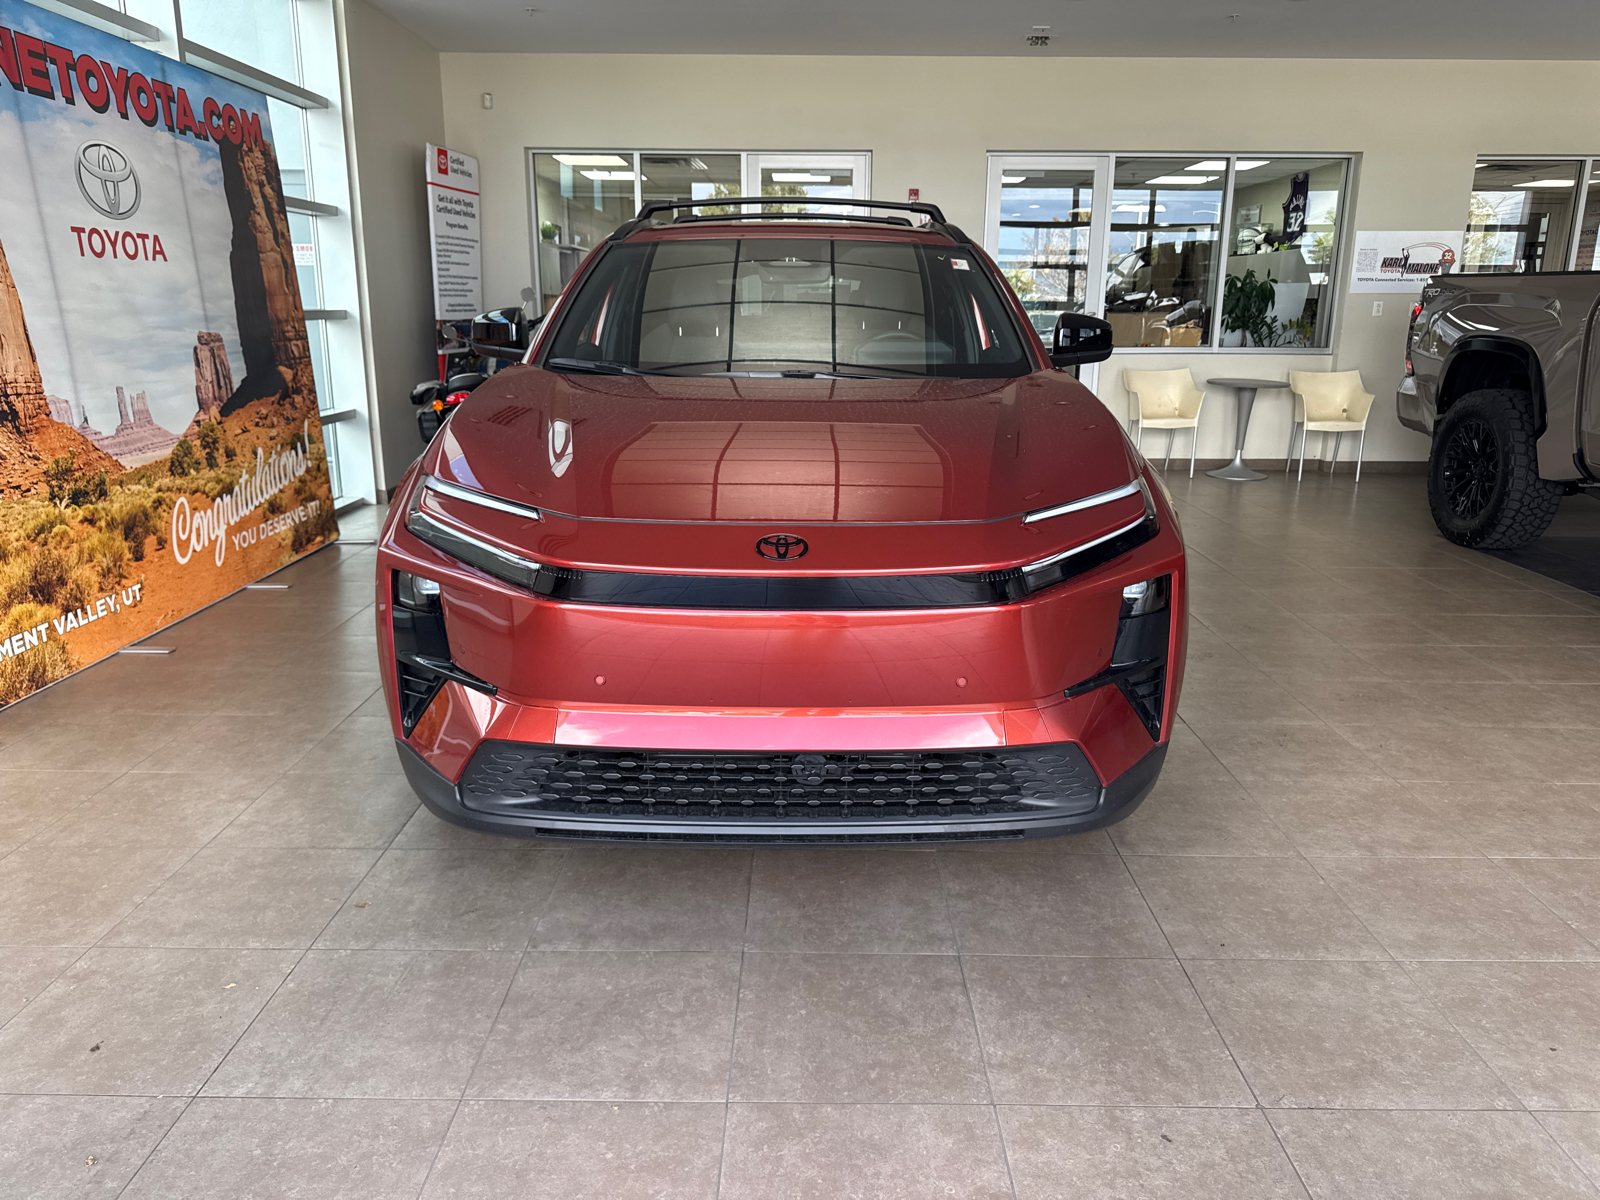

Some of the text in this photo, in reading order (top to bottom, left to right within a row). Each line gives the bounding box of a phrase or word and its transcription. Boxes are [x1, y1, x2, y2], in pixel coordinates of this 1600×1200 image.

[450, 156, 465, 167] Certified
[436, 204, 452, 215] Certified
[462, 198, 474, 209] Toyota
[1286, 211, 1304, 232] 32
[70, 226, 168, 262] TOYOTA
[1444, 252, 1452, 260] 32
[1380, 257, 1440, 274] KARL MALONE
[1424, 288, 1441, 298] TRD
[172, 418, 312, 567] Congratulations!
[231, 499, 321, 551] YOU DESERVE IT!
[52, 593, 121, 636] VALLEY,
[121, 583, 142, 606] UT
